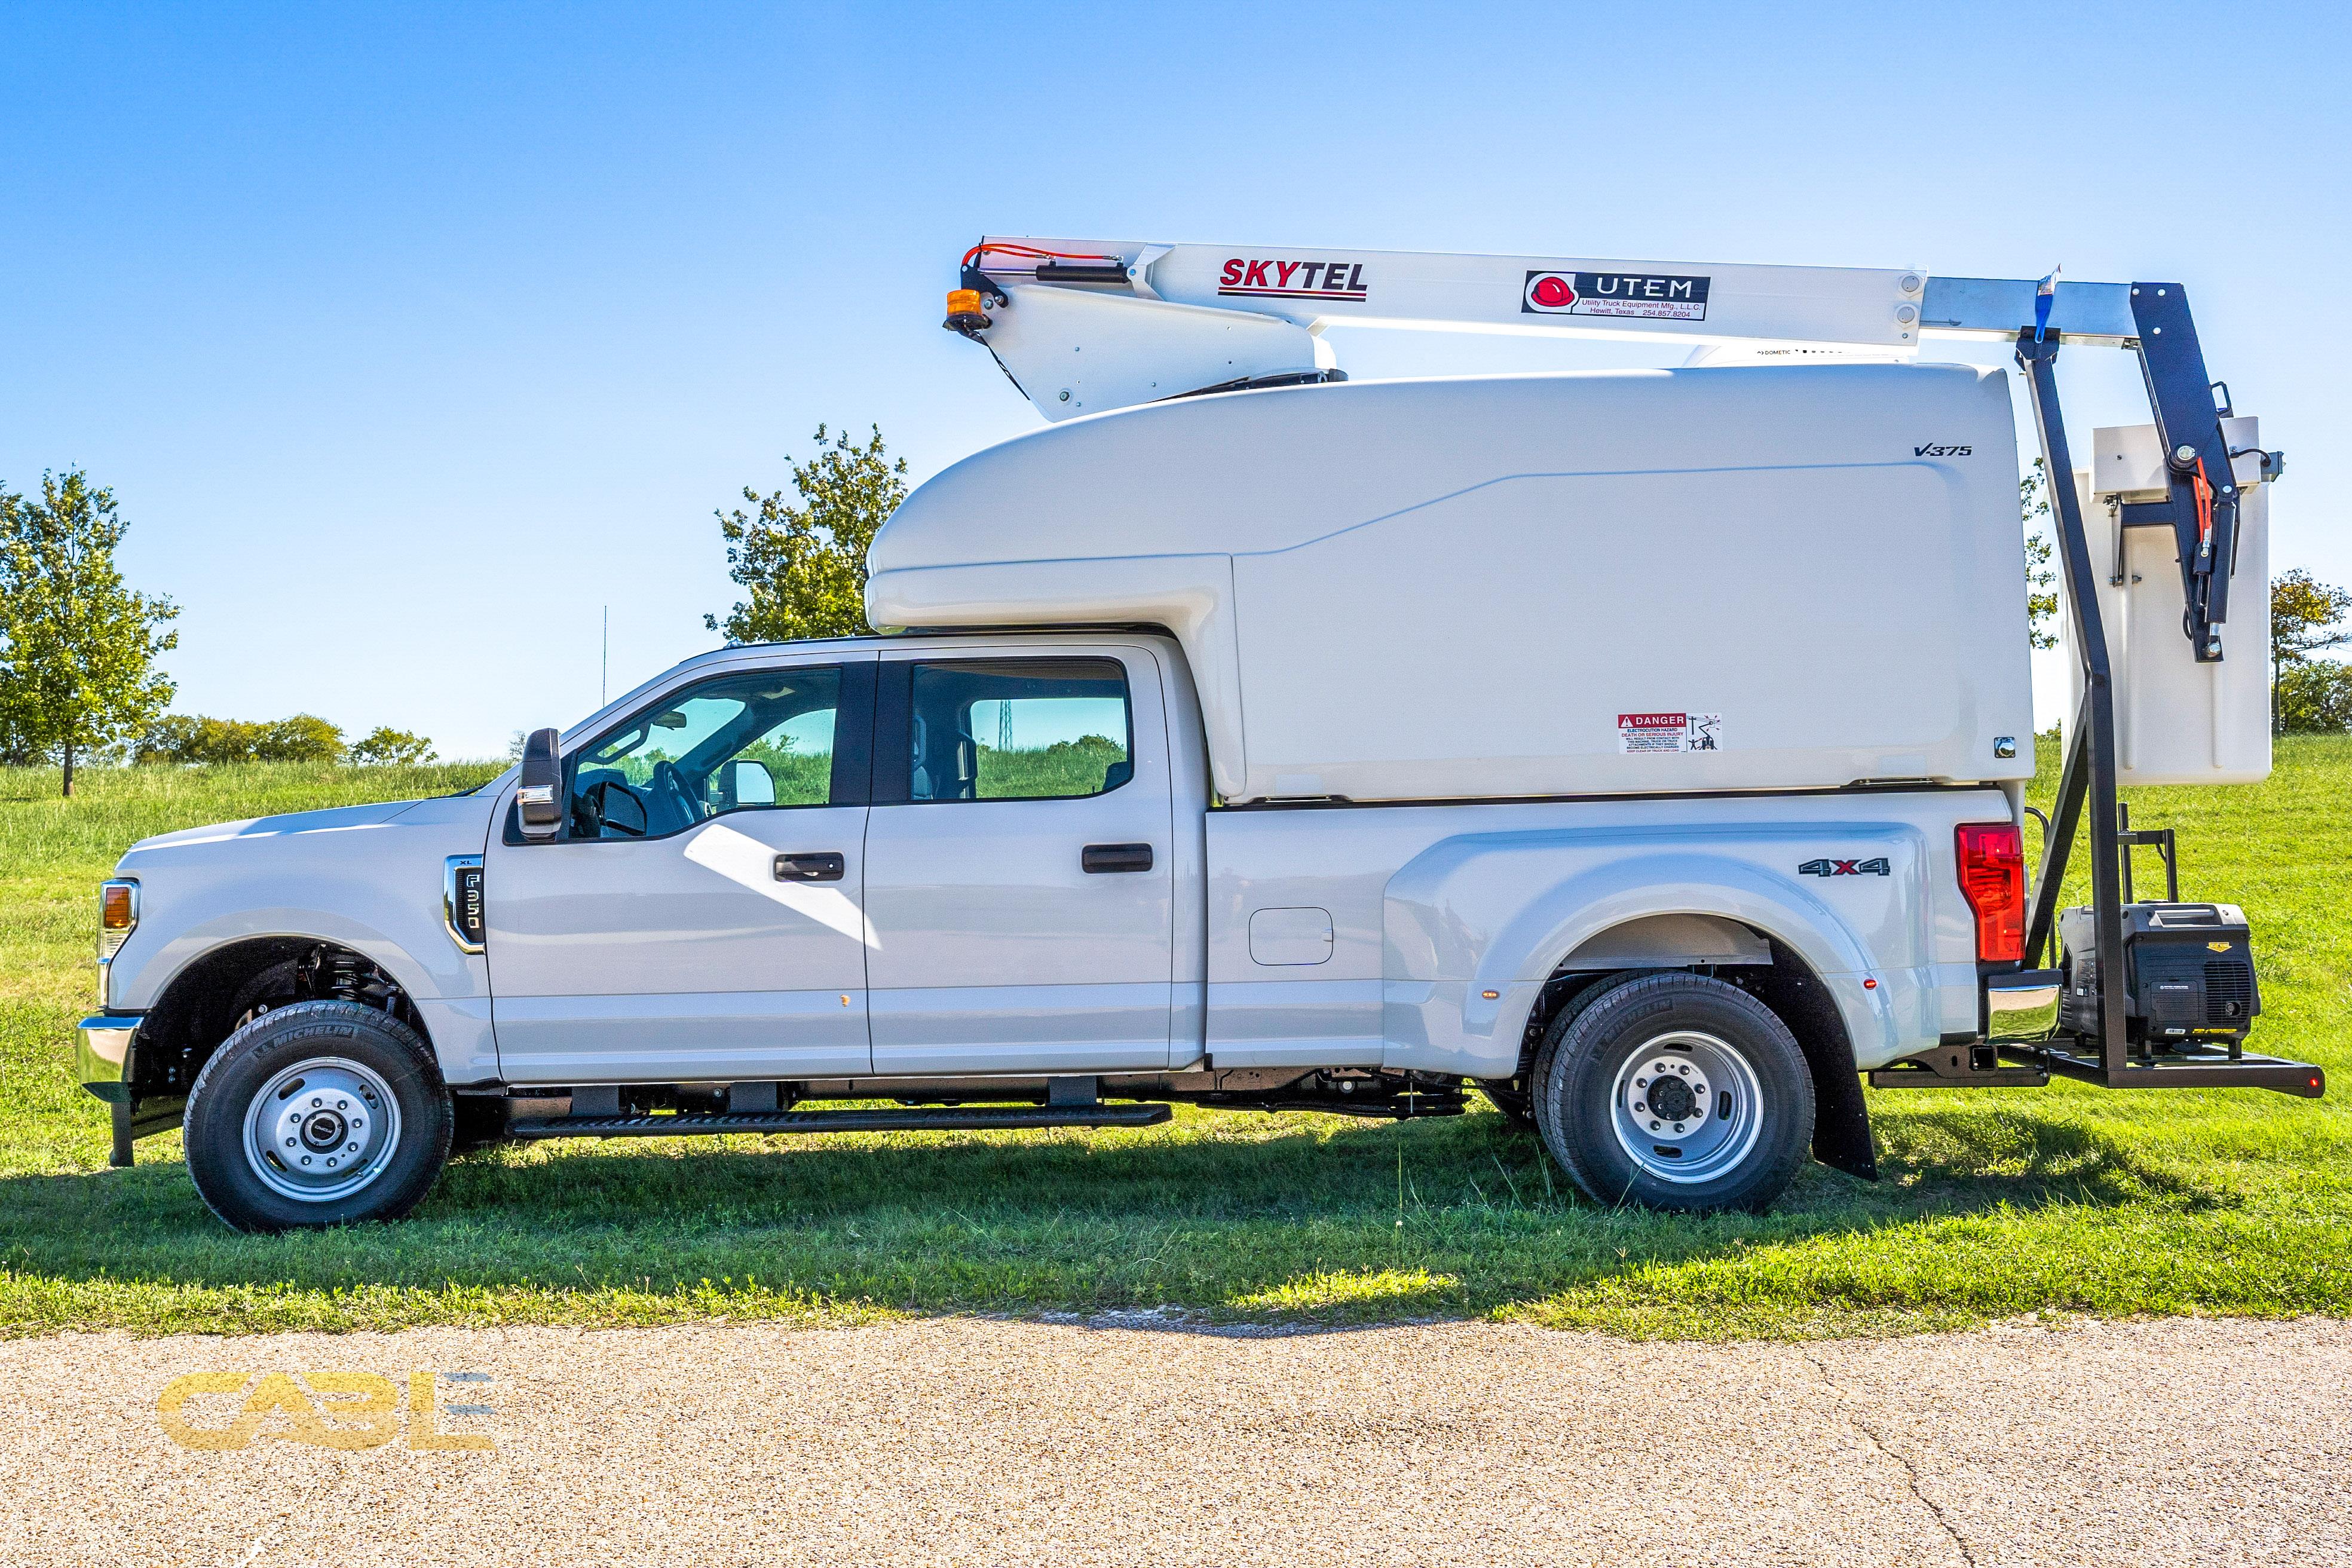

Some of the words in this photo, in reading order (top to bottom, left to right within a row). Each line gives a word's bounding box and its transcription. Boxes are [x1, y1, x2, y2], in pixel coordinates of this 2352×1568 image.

[1220, 258, 1368, 291] SKYTEL
[1597, 277, 1692, 298] UTEM
[1582, 299, 1600, 307] Utility
[1622, 301, 1659, 310] Equipment
[1643, 310, 1690, 318] 254.857.8204
[1636, 716, 1684, 725] DANGER
[466, 874, 480, 928] F350
[273, 1025, 354, 1047] MICHELIN
